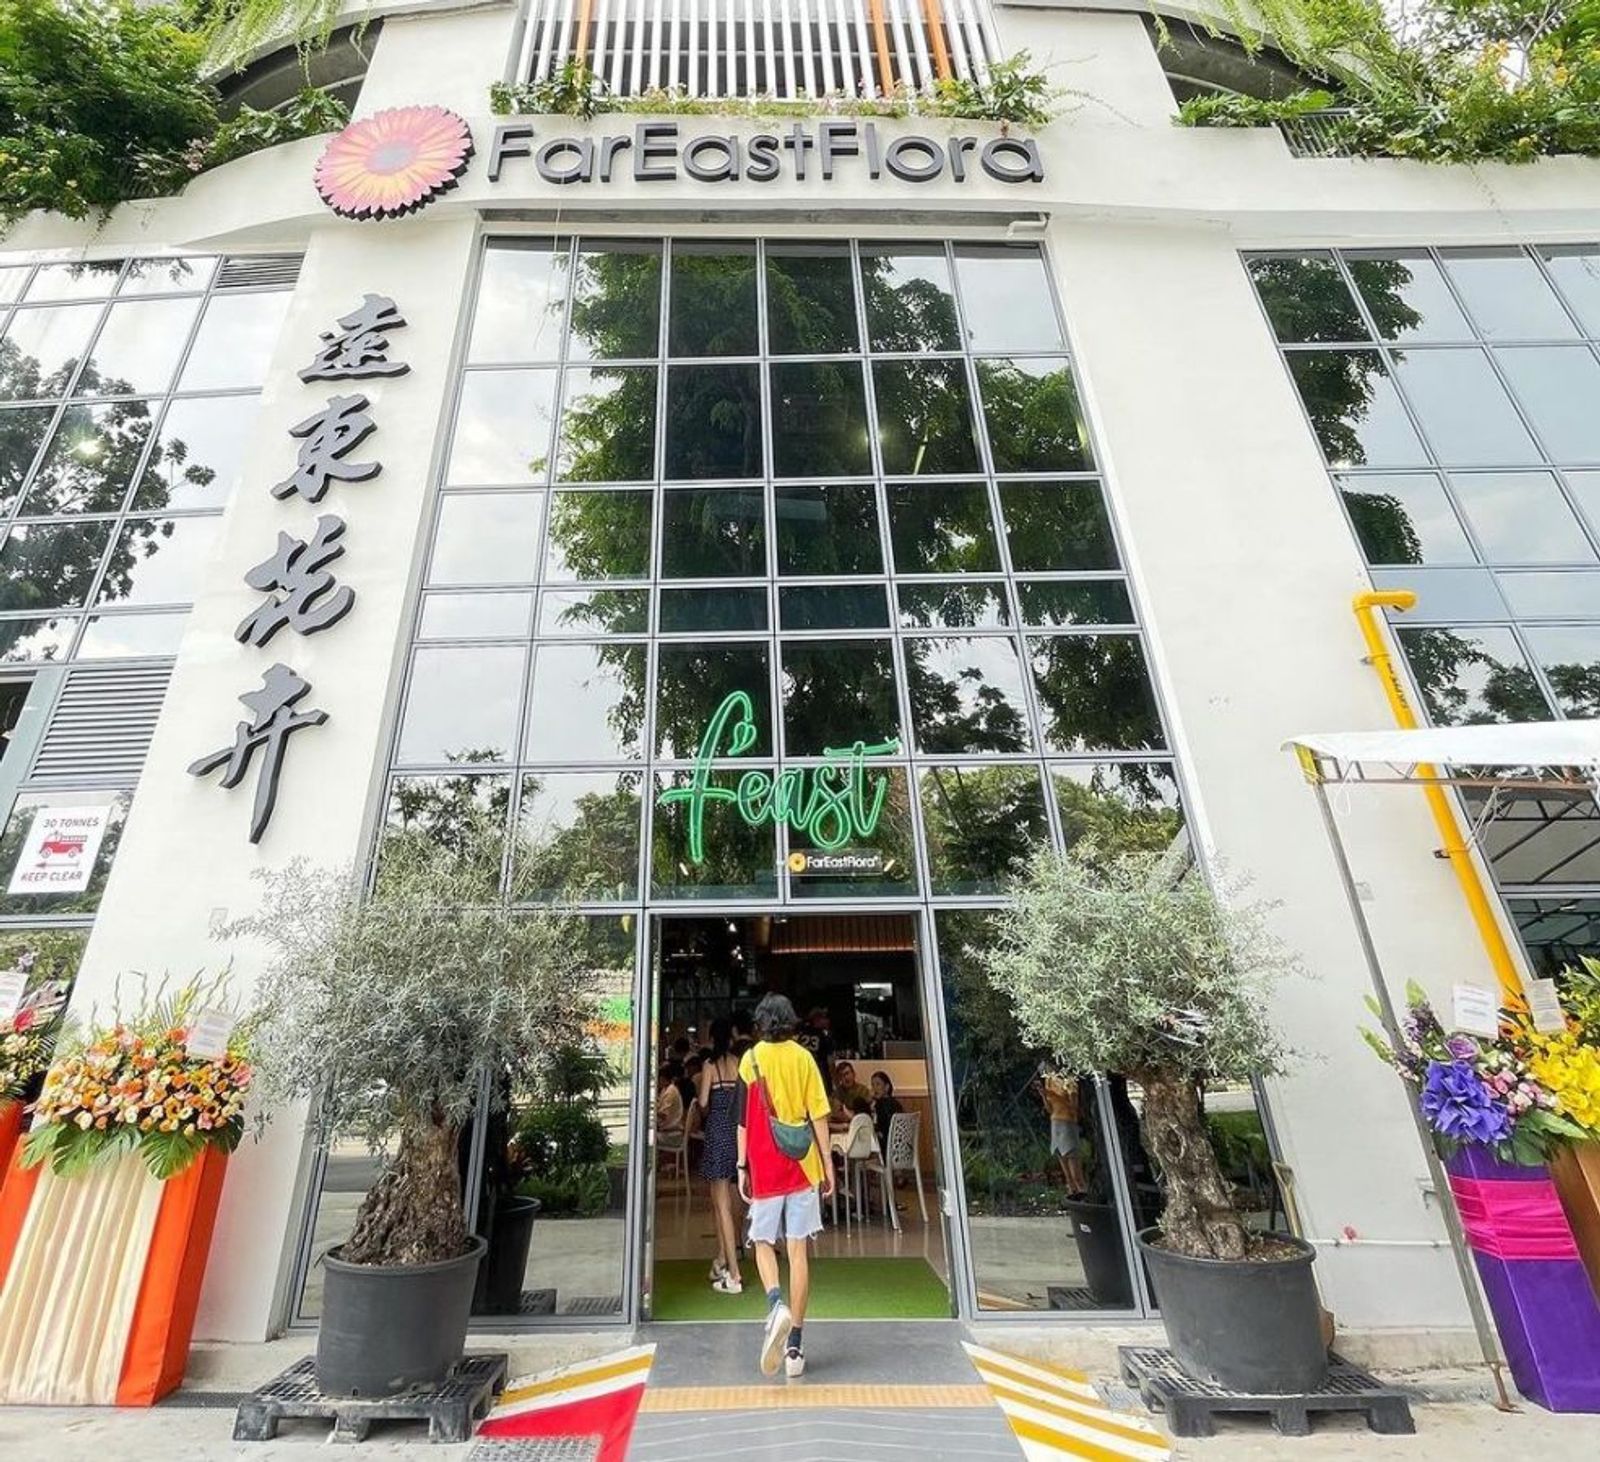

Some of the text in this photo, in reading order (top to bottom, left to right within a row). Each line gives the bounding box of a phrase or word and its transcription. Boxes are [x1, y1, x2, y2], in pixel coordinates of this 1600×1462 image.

[487, 122, 1045, 184] FarEastFlora
[658, 690, 901, 864] feast
[43, 817, 99, 828] 30 TONNES
[21, 871, 83, 881] KEEP CLEAR
